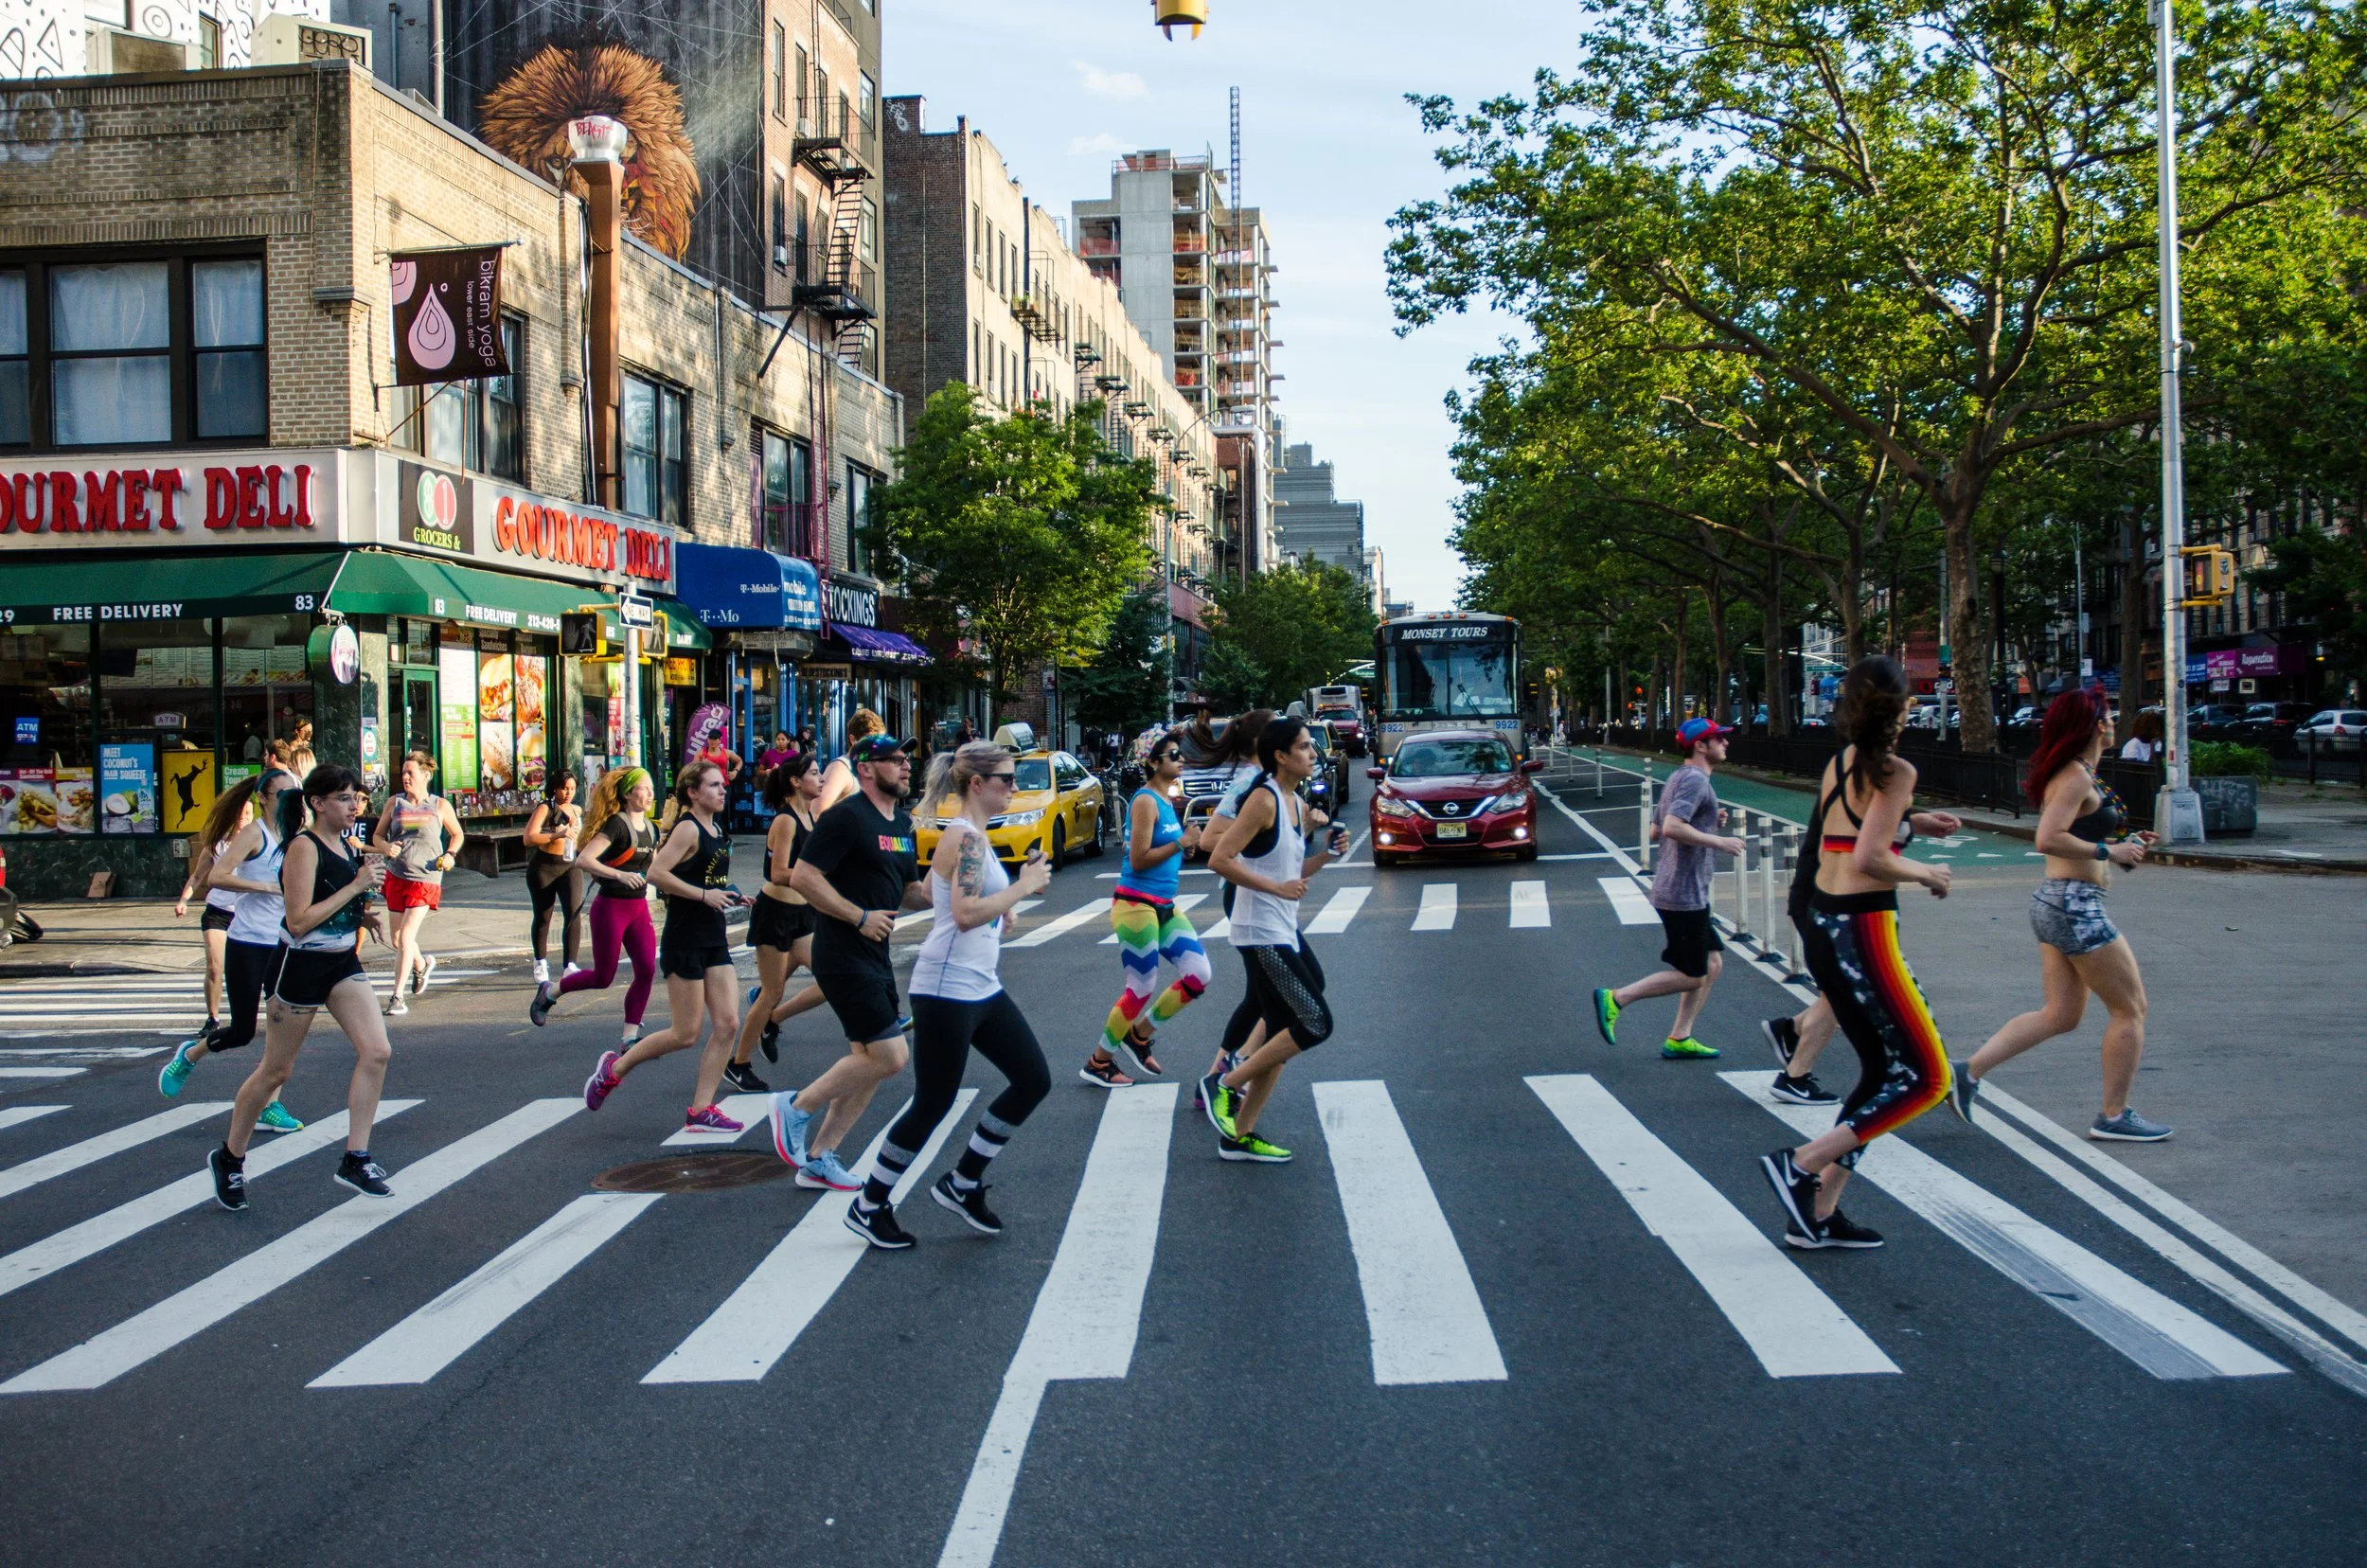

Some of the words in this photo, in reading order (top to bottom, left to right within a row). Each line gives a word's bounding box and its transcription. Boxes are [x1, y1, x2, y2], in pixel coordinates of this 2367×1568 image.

[479, 260, 494, 318] bikram
[477, 324, 496, 367] yoga
[204, 464, 312, 528] DELI
[414, 526, 453, 548] GROCERS
[454, 539, 460, 551] &
[495, 496, 618, 571] GOURMET
[625, 527, 671, 581] DELI
[784, 579, 807, 596] mobile
[53, 606, 93, 621] FREE
[100, 603, 184, 618] DELIVERY
[294, 595, 313, 611] 83
[435, 597, 445, 615] 83
[465, 604, 483, 620] FREE
[484, 607, 517, 625] DELIVERY
[527, 615, 561, 632] 212-420-5
[1401, 629, 1447, 640] MONSEY
[1450, 627, 1487, 638] TOURS
[16, 722, 38, 732] ATM
[1381, 723, 1404, 733] 9922
[1496, 721, 1518, 729] 9922
[103, 747, 121, 757] MEET
[103, 757, 138, 768] COCONUT'S
[341, 823, 366, 838] OVE
